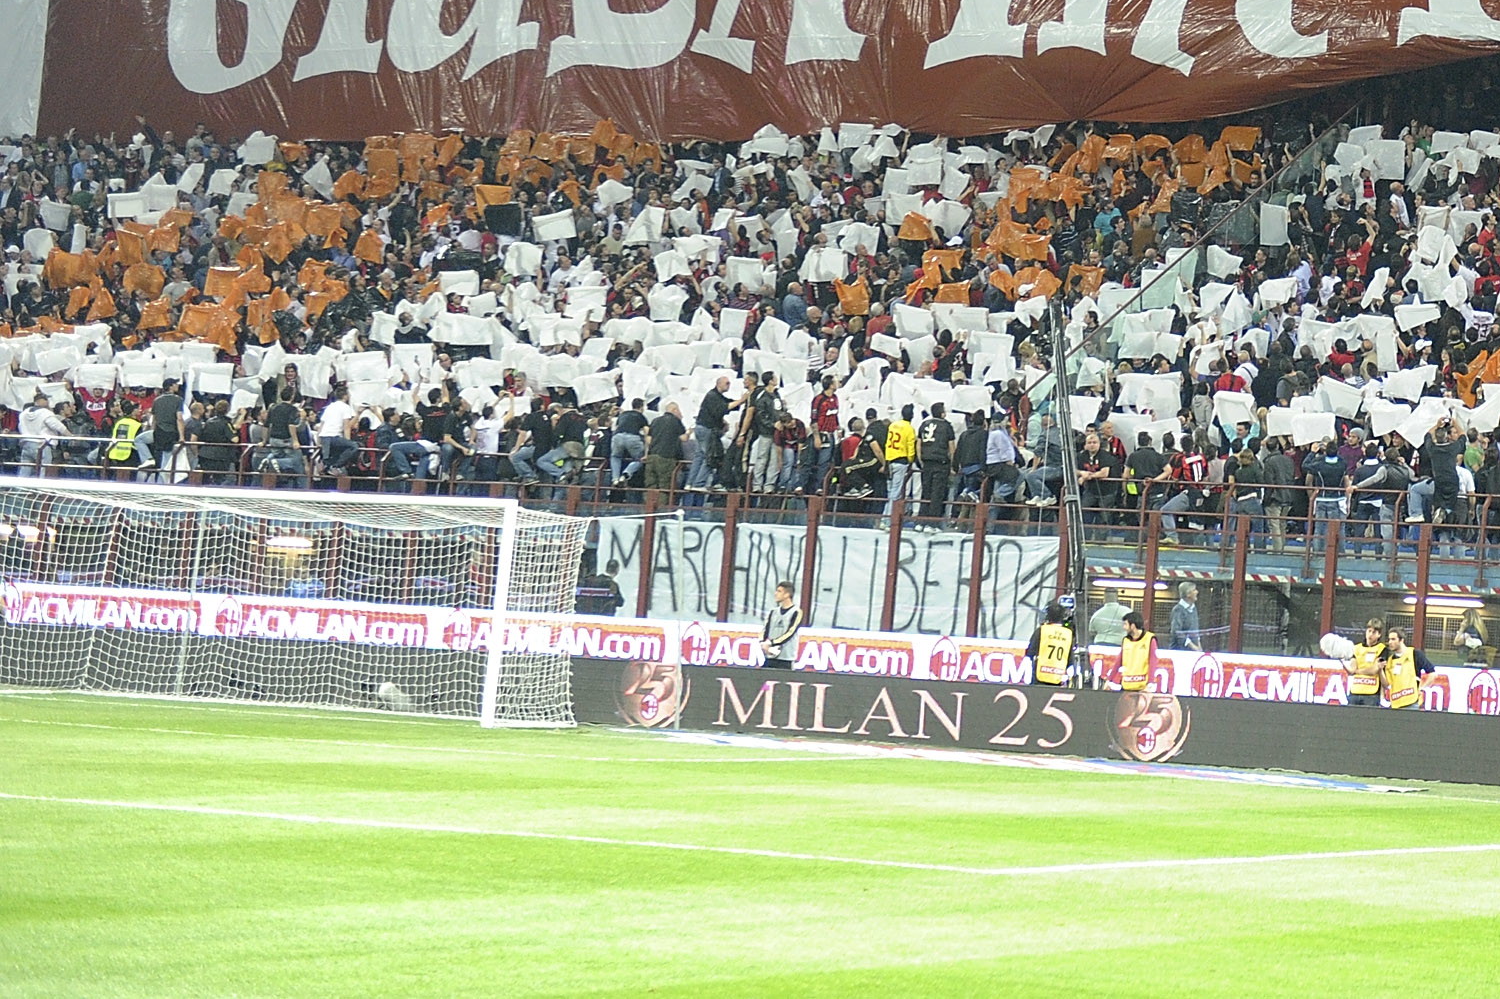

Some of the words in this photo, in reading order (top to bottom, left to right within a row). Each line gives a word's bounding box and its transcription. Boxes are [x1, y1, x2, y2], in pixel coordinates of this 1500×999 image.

[1047, 645, 1064, 661] 70
[711, 677, 969, 741] MILAN
[988, 688, 1077, 749] 25
